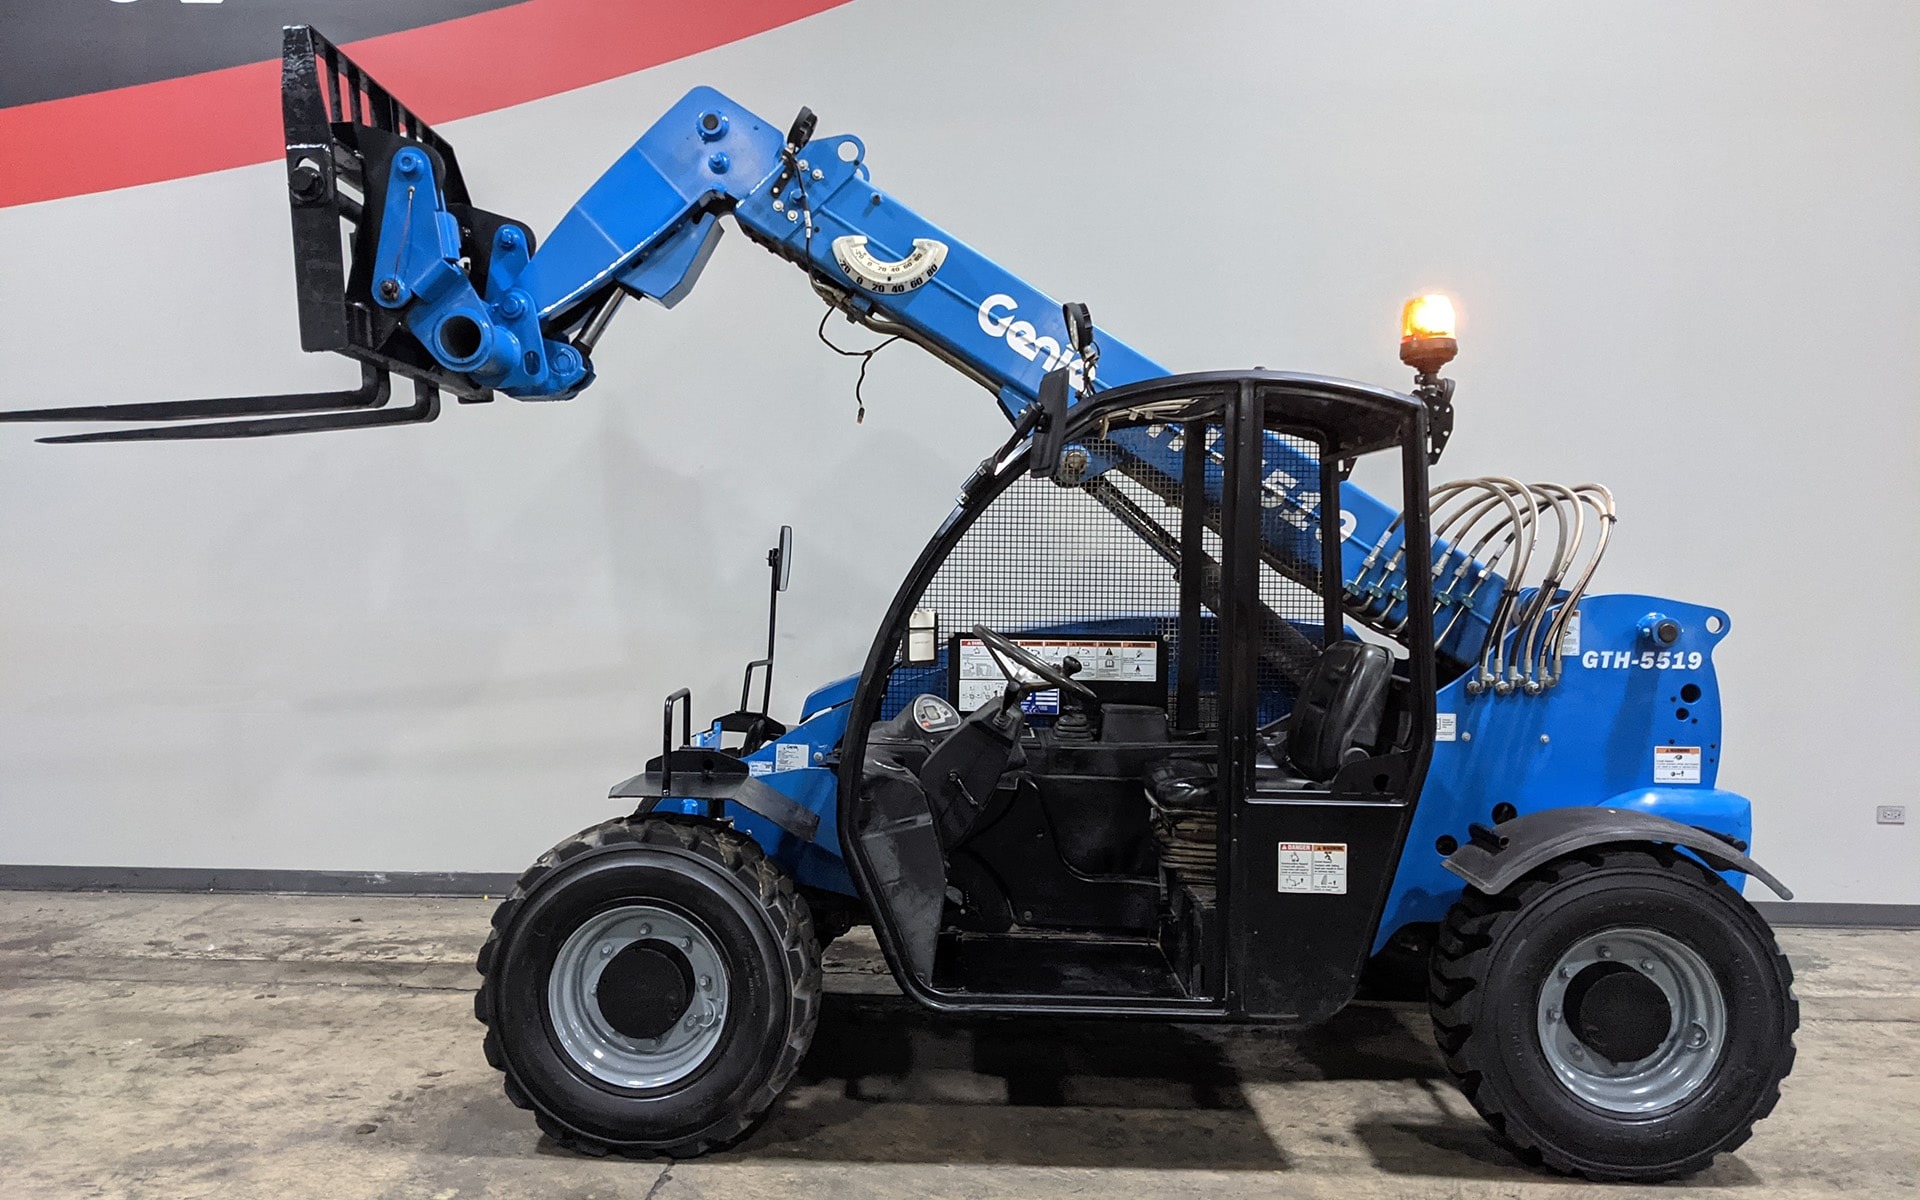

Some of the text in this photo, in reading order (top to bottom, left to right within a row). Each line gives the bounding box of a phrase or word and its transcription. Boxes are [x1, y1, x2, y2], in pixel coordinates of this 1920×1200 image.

[856, 276, 864, 286] 0
[872, 283, 885, 293] 20
[891, 284, 905, 293] 40
[910, 277, 923, 289] 60
[926, 264, 938, 278] 80
[1582, 650, 1703, 670] GTH-5519
